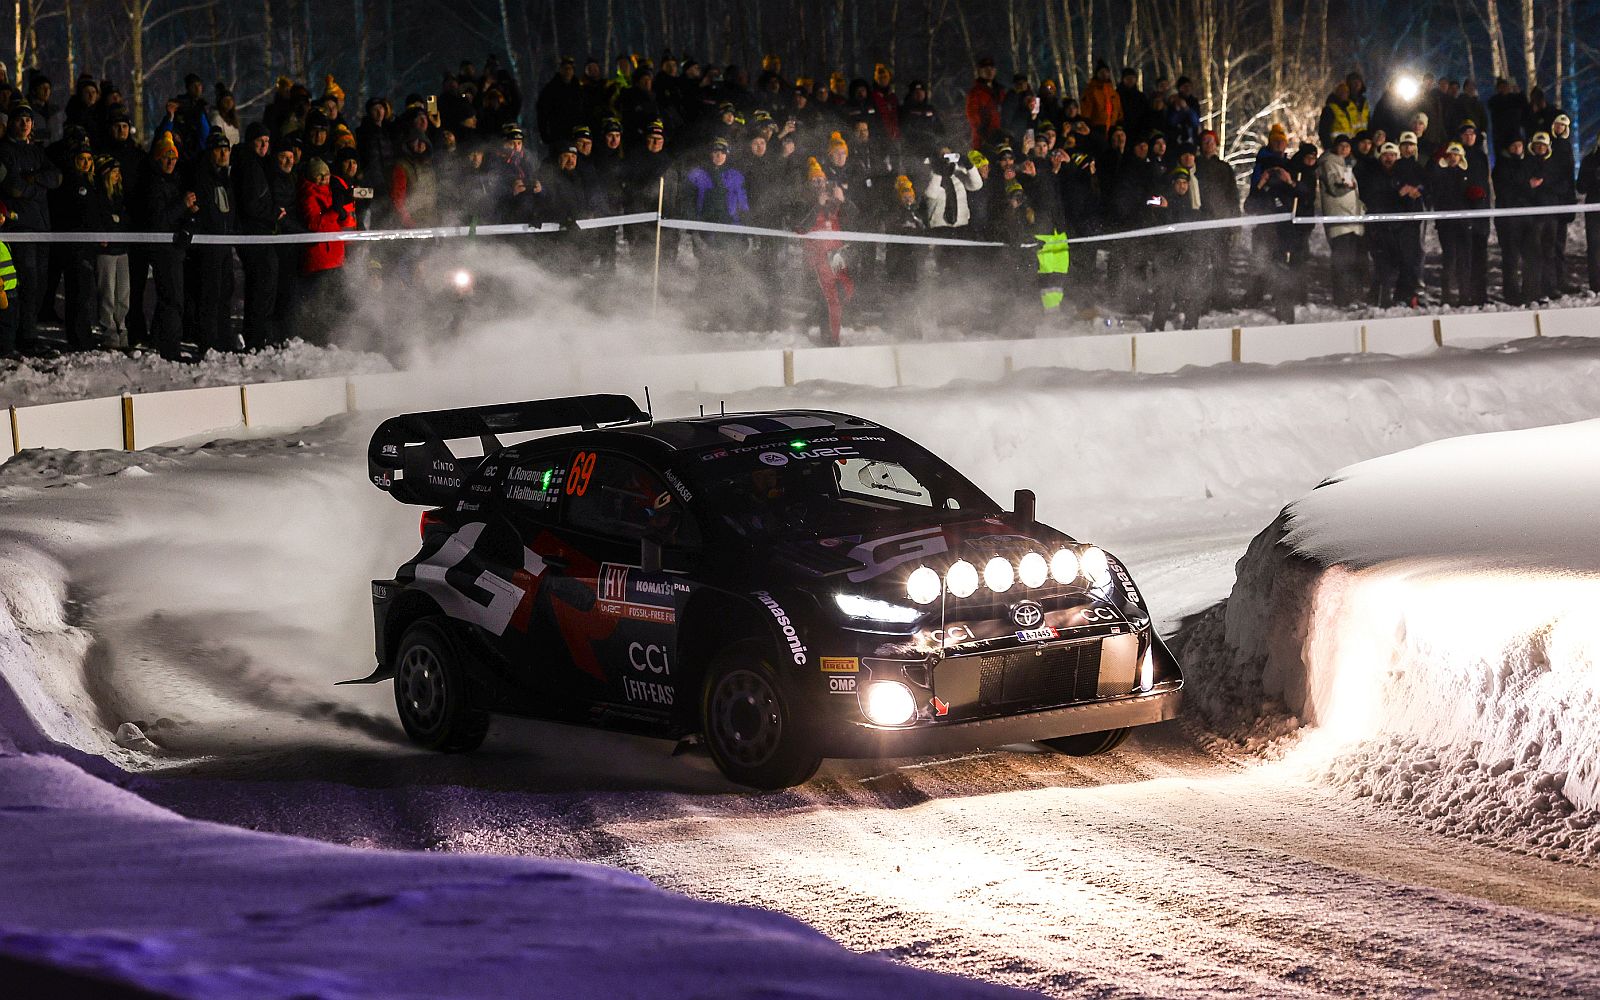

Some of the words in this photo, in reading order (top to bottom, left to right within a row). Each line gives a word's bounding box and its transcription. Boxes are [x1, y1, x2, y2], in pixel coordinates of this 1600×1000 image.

[789, 446, 860, 460] WRC
[428, 474, 462, 488] TAMADIC
[507, 465, 552, 485] K.Rovanpe
[566, 450, 598, 498] 69
[605, 567, 626, 598] HY
[674, 583, 691, 593] PIAA
[628, 607, 665, 620] FOSSIL-FREE
[749, 590, 807, 666] Panasonic
[822, 659, 856, 670] PIRELLI
[829, 678, 857, 691] OMP
